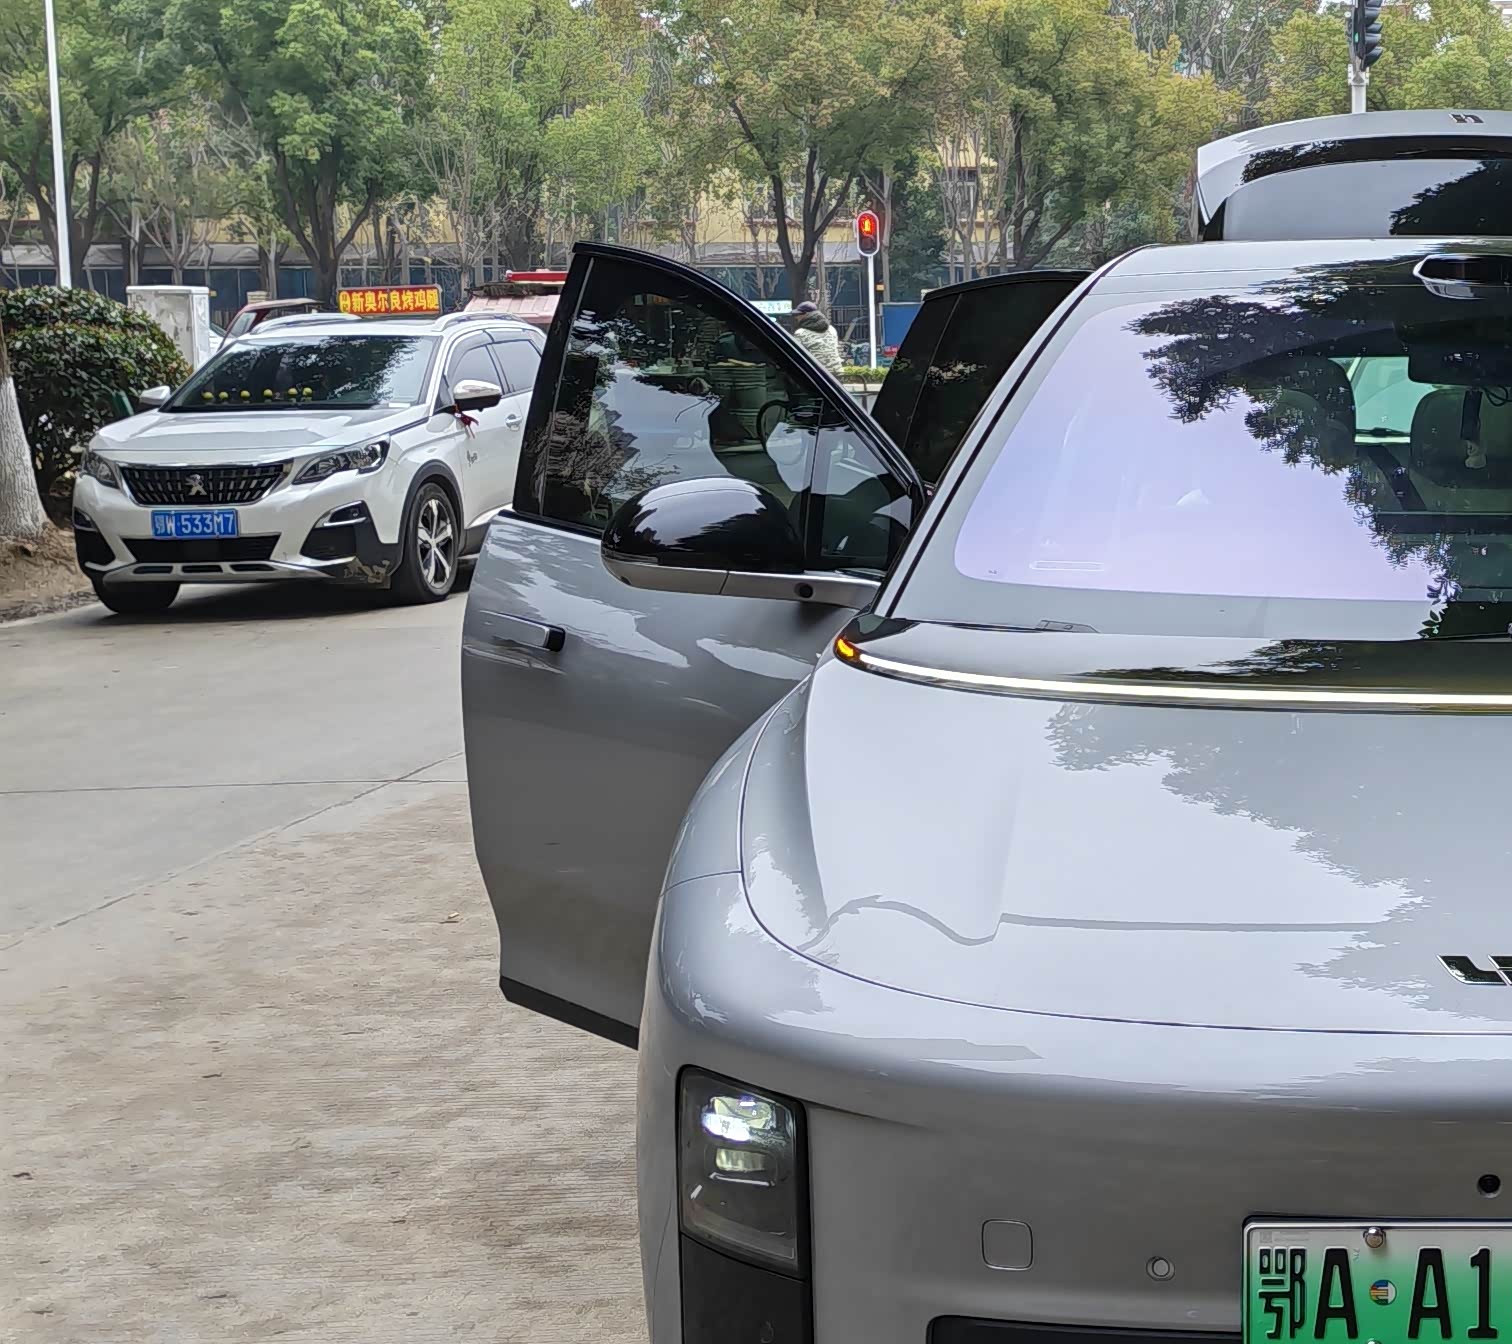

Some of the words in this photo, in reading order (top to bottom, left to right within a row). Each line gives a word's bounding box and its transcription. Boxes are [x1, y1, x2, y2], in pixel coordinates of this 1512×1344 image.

[352, 288, 440, 313] 新奥尔良烤鸡腿
